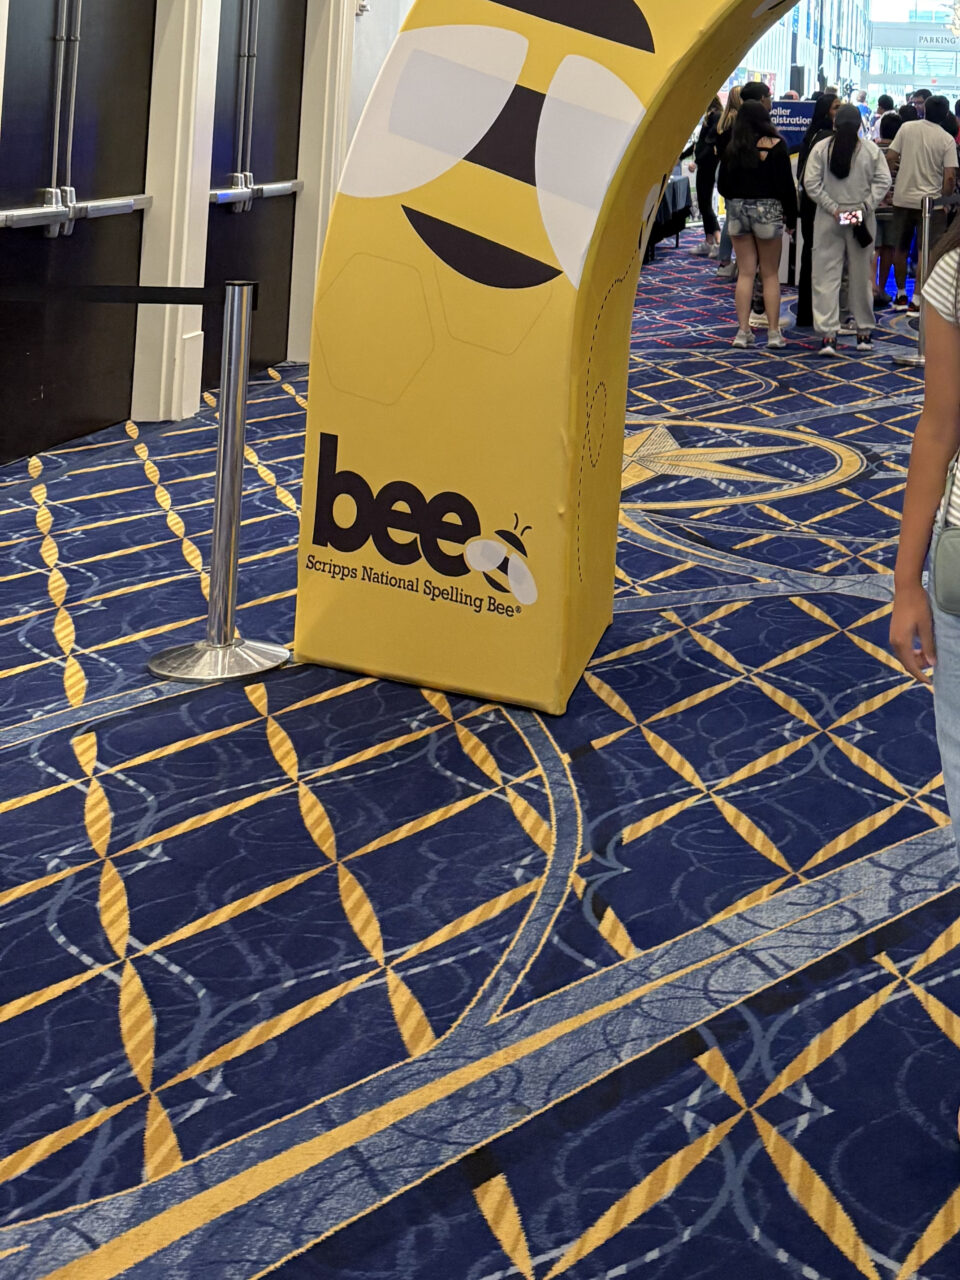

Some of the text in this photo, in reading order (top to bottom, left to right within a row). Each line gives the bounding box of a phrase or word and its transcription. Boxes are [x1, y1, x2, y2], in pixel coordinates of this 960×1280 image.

[918, 35, 957, 45] PARKING
[312, 432, 482, 577] bee
[306, 554, 358, 580] Scripps
[361, 565, 419, 594] National
[423, 579, 484, 614] Spelling
